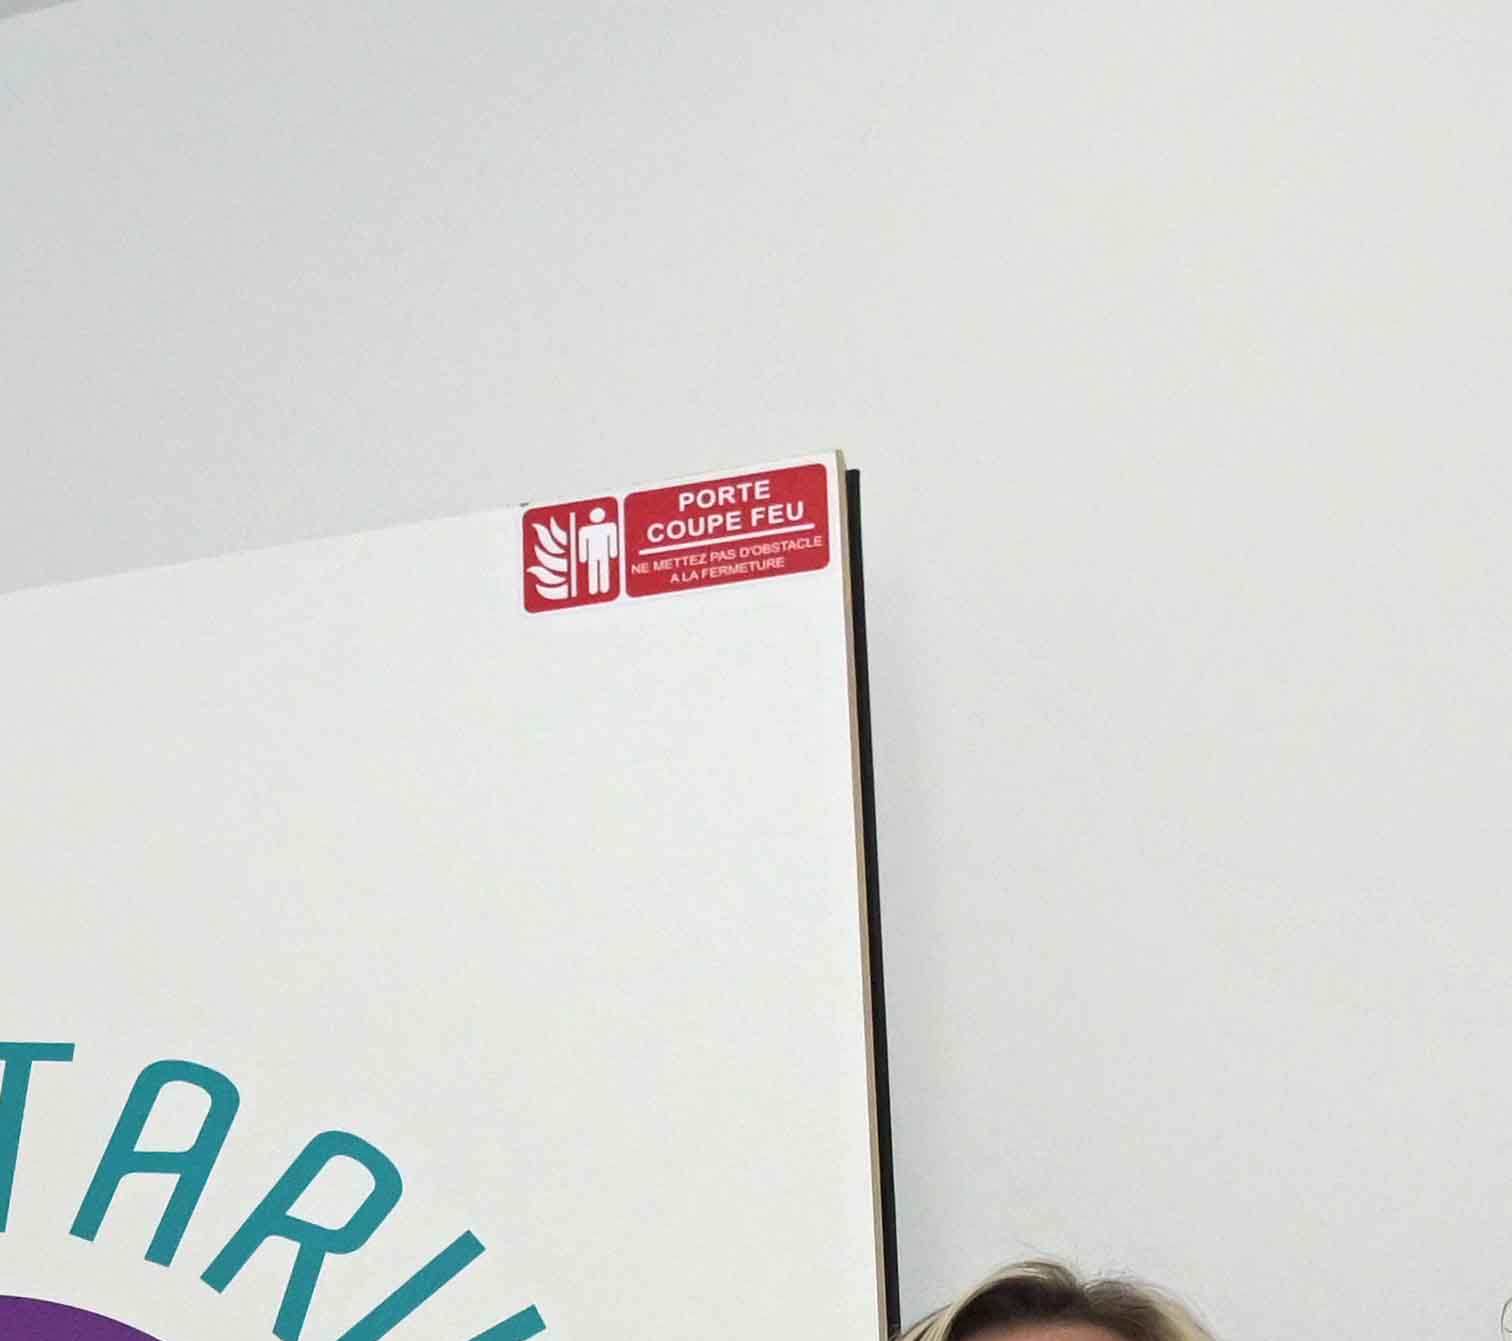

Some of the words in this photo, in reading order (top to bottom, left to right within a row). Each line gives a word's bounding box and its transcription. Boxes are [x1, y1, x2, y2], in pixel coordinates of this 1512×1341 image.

[678, 480, 771, 512] PORTE
[646, 511, 743, 543] COUPE
[751, 501, 804, 527] FEU
[631, 562, 649, 576] NE
[653, 552, 708, 572] METTEZ
[710, 548, 737, 563] PAS
[739, 535, 823, 559] D'OBSTACLE
[670, 574, 680, 584] A
[682, 569, 699, 583] LA
[702, 556, 785, 579] FERMETURE
